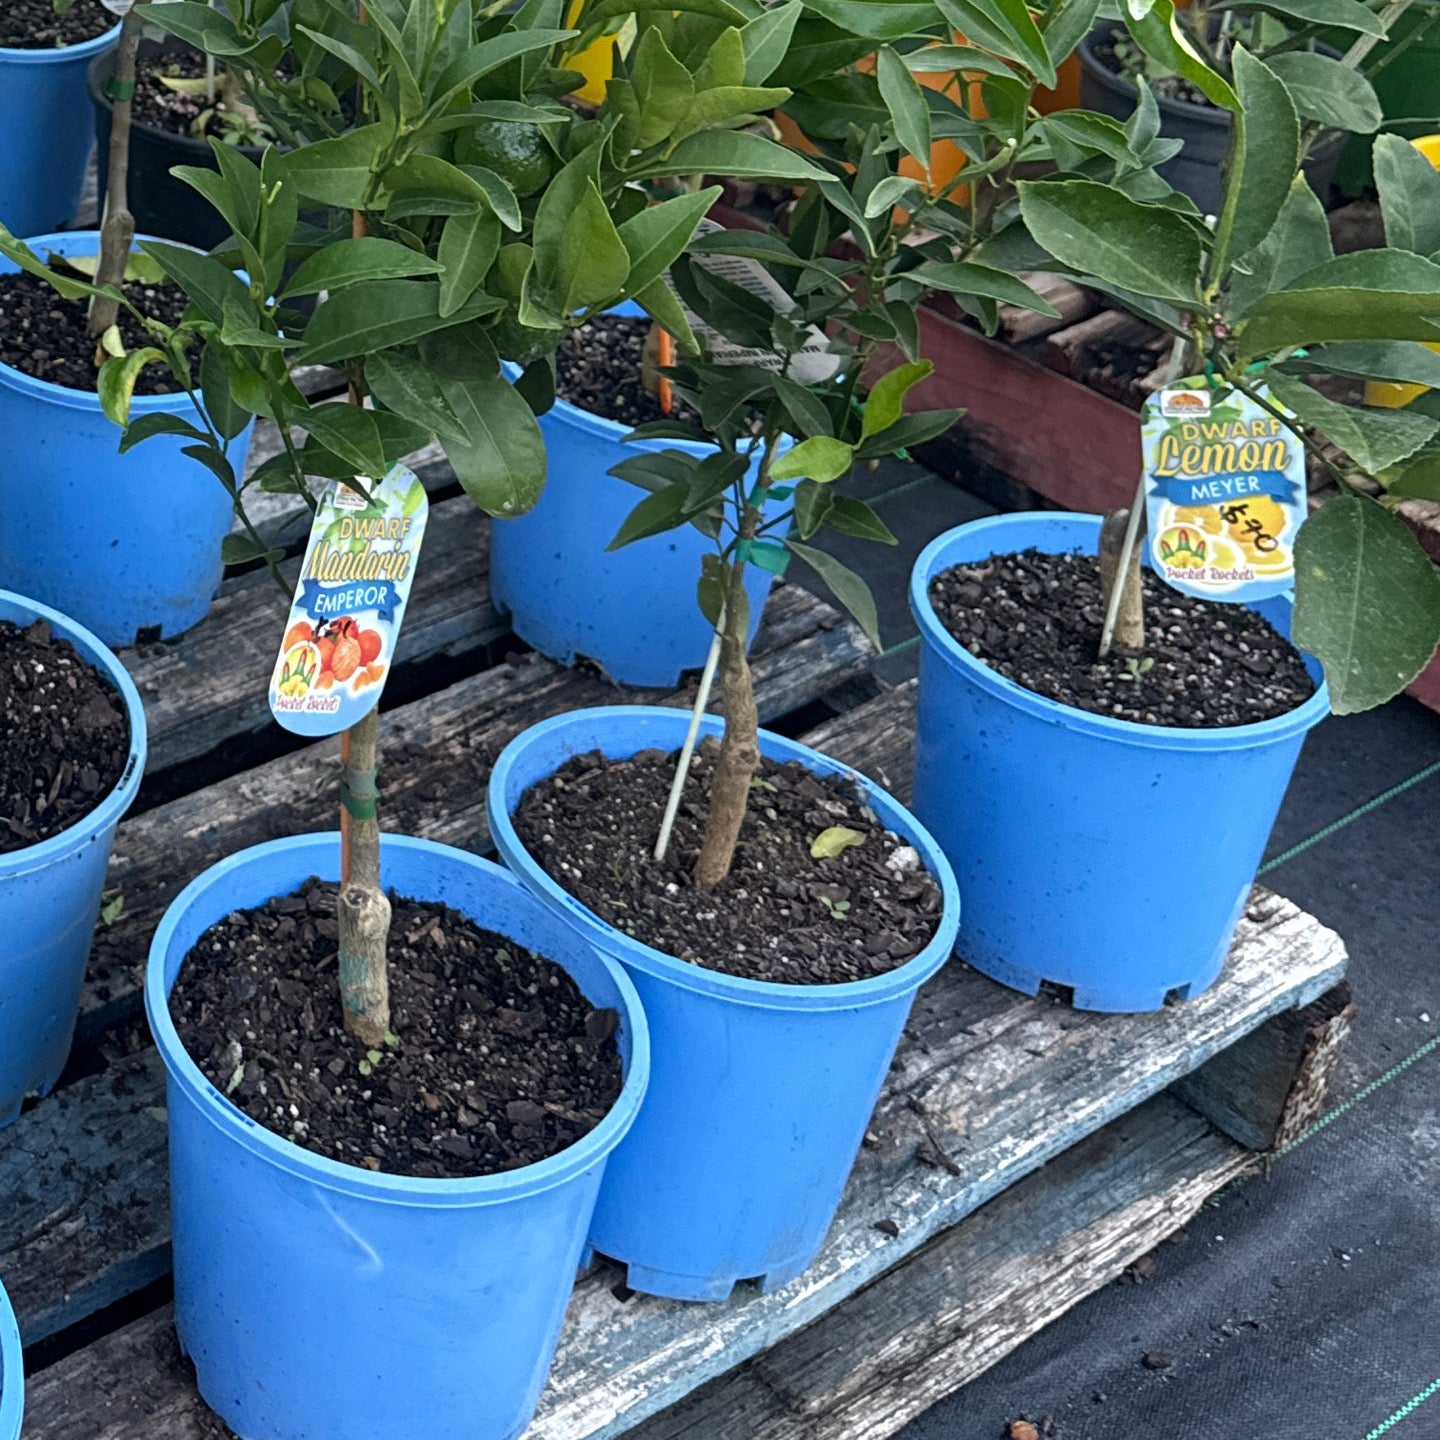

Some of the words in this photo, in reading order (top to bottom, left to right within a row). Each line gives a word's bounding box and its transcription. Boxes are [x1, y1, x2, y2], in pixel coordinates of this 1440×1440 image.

[1182, 418, 1281, 441] DWARF
[1155, 434, 1291, 477] Lemon
[1191, 476, 1261, 500] MEYER
[339, 518, 411, 539] DWARF
[304, 540, 410, 582] Mandarin
[315, 586, 387, 613] EMPEROR
